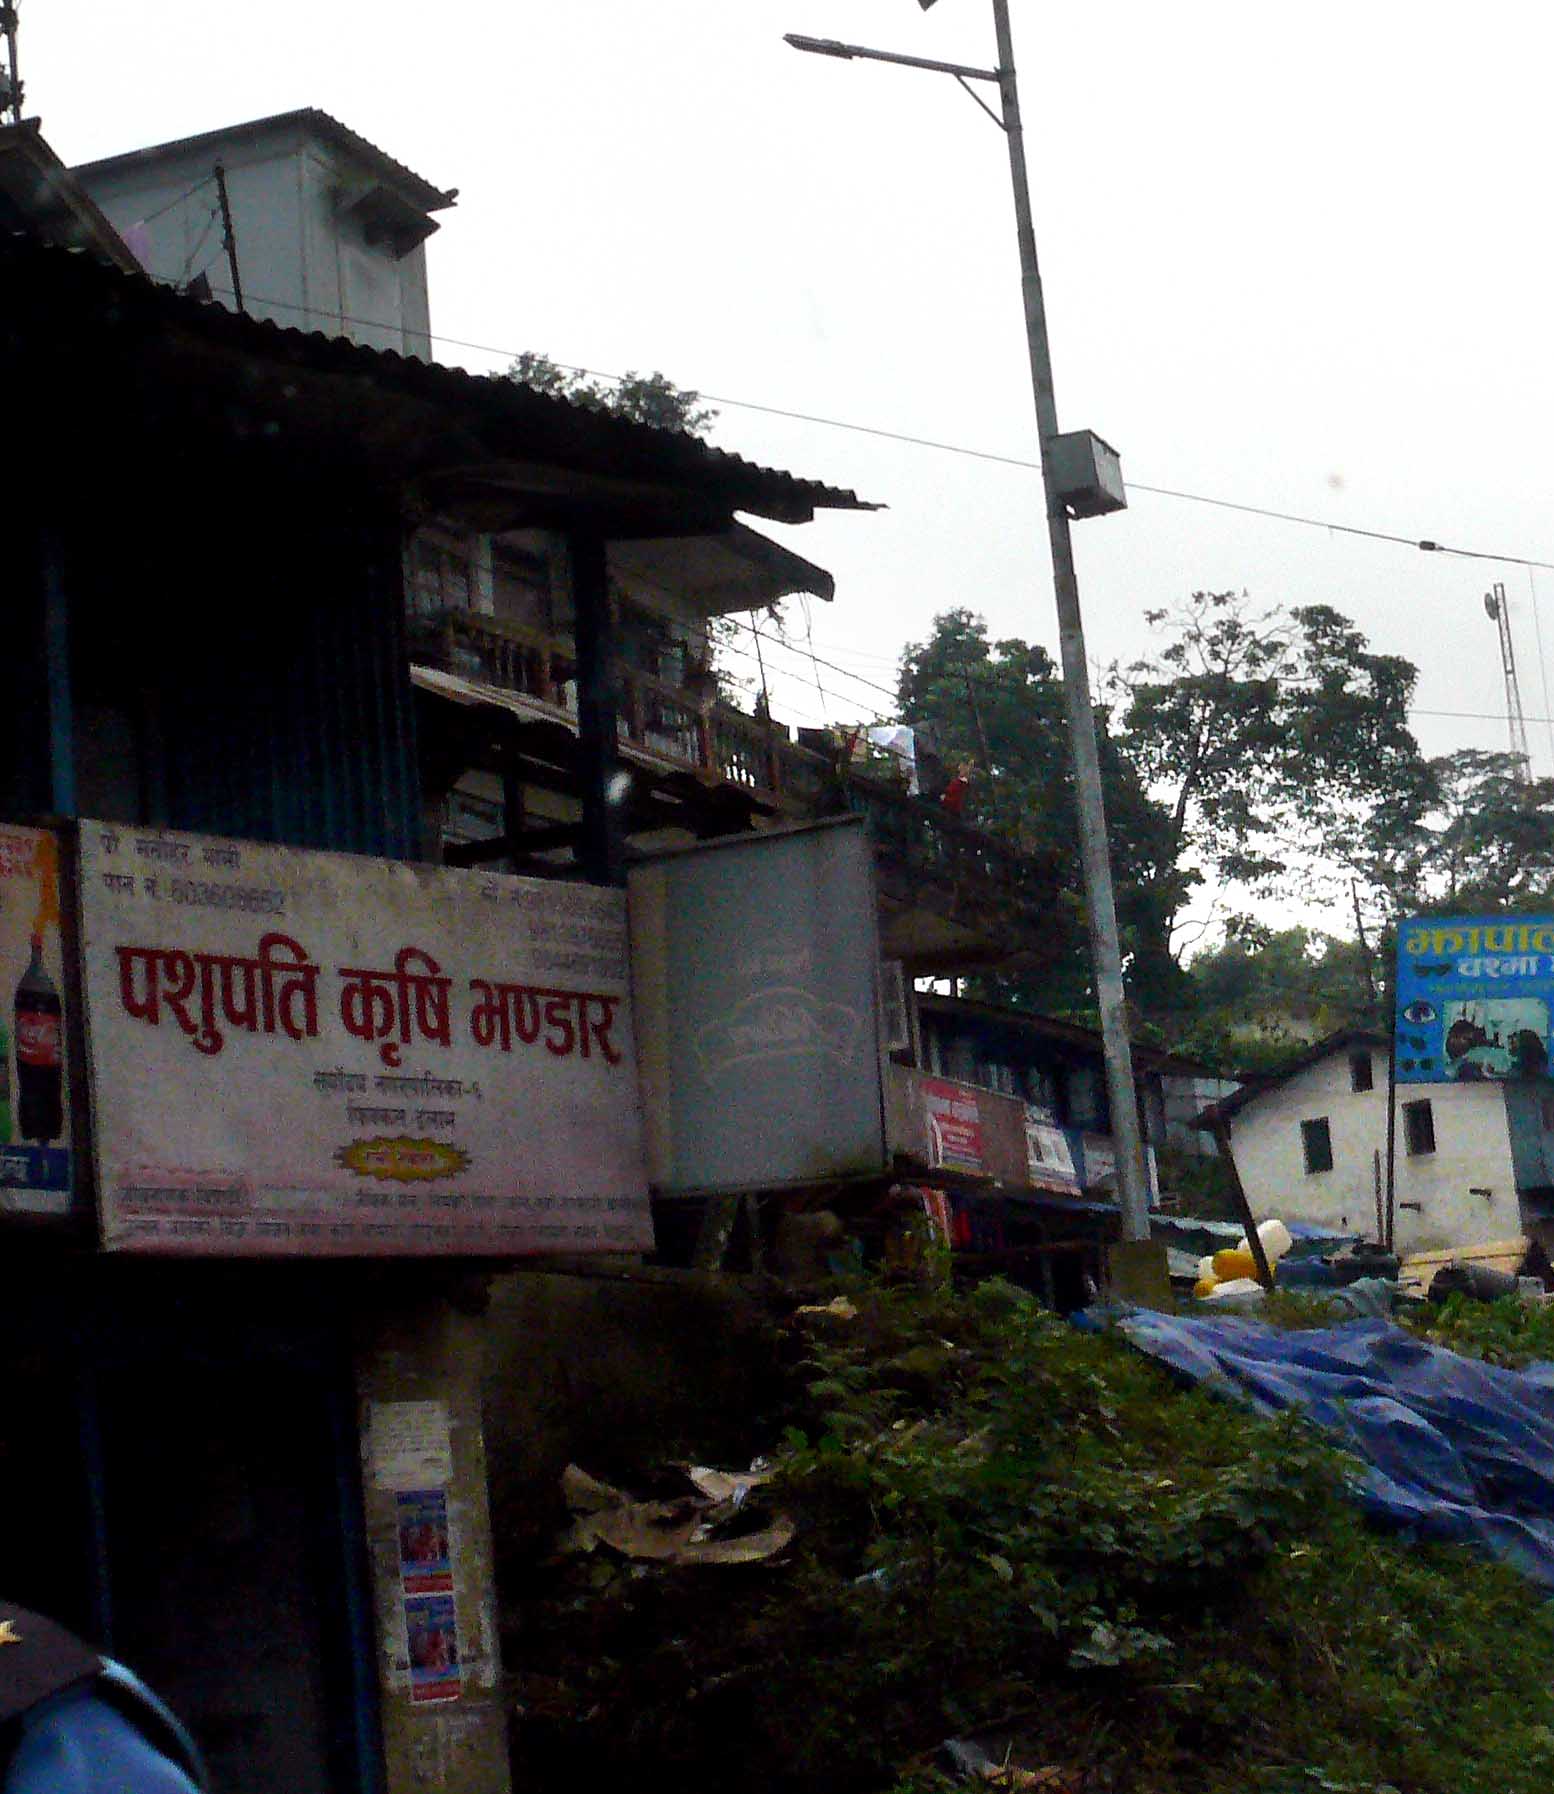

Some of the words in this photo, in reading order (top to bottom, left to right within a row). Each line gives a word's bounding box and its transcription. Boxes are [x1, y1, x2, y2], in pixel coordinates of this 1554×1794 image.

[114, 931, 320, 1056] पशुपति
[338, 945, 454, 1068] कृषि
[469, 977, 622, 1066] भण्डार
